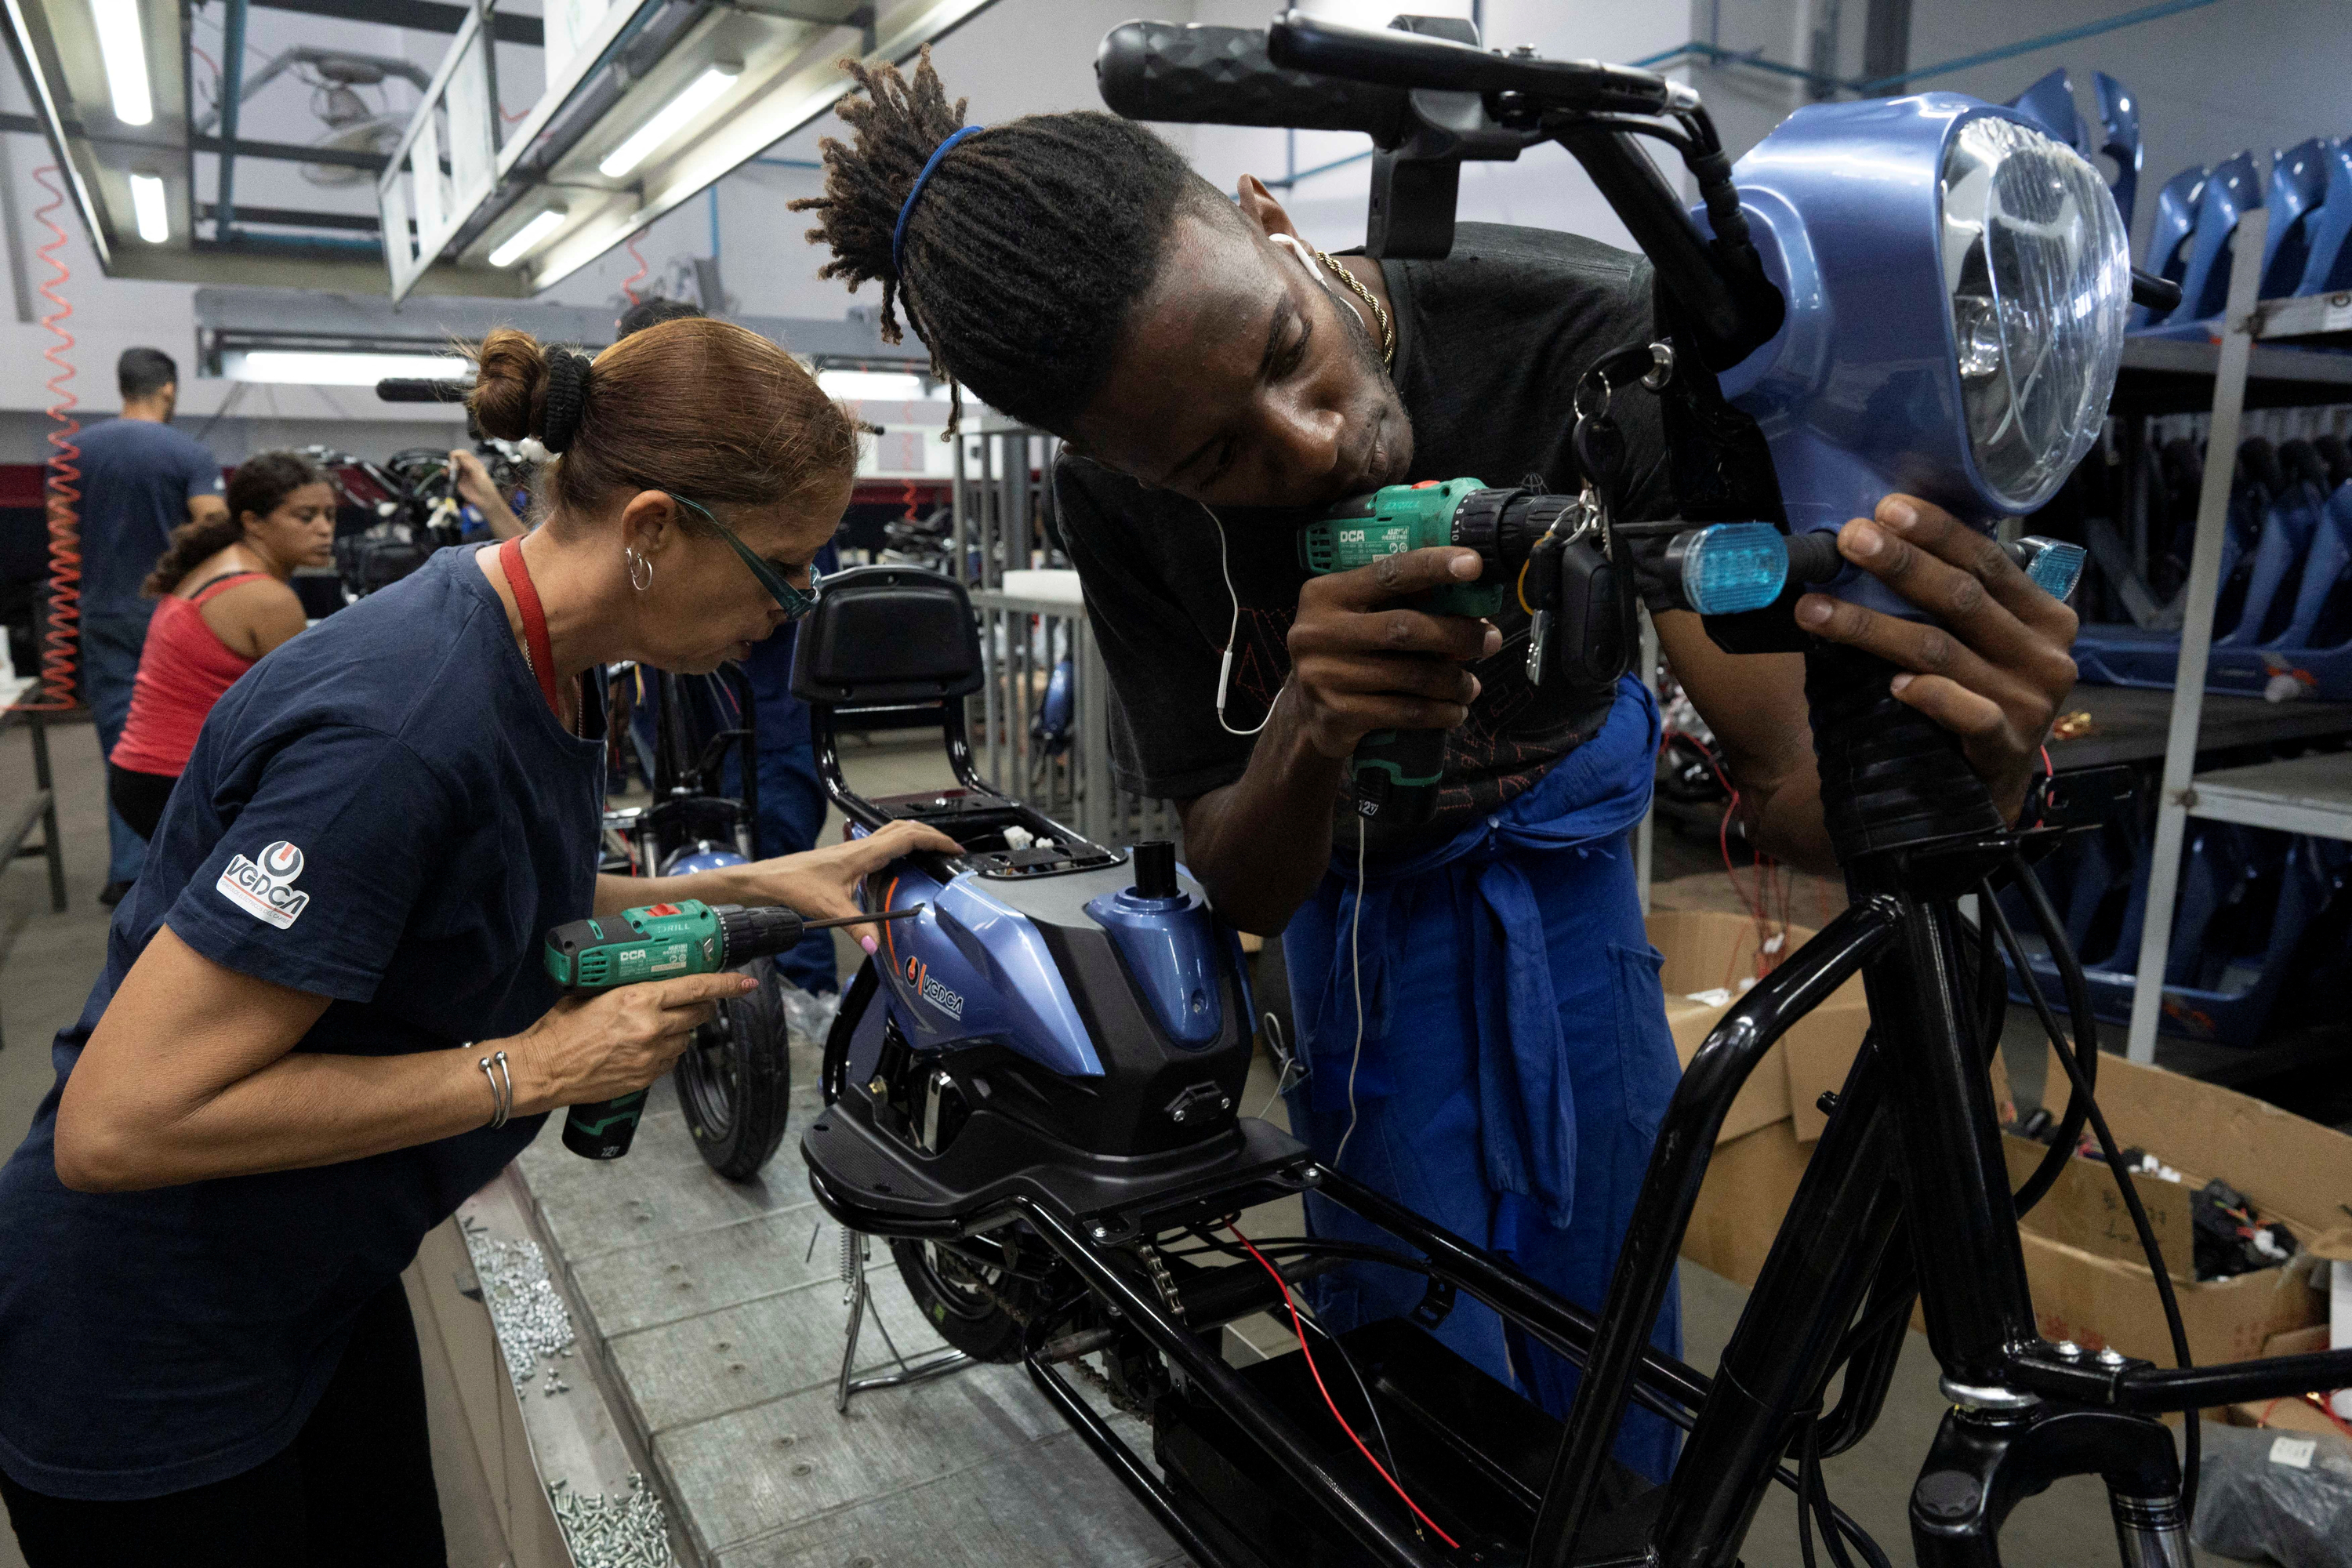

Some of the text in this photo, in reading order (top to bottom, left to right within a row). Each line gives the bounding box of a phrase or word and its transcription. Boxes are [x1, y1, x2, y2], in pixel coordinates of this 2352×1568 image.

[1340, 530, 1365, 543] DCA
[1452, 528, 1460, 541] 10
[227, 856, 307, 915] VGDCA
[263, 908, 274, 916] DEL
[658, 924, 690, 933] DRILL
[620, 949, 646, 961] DCA
[924, 975, 964, 1014] VGDCA
